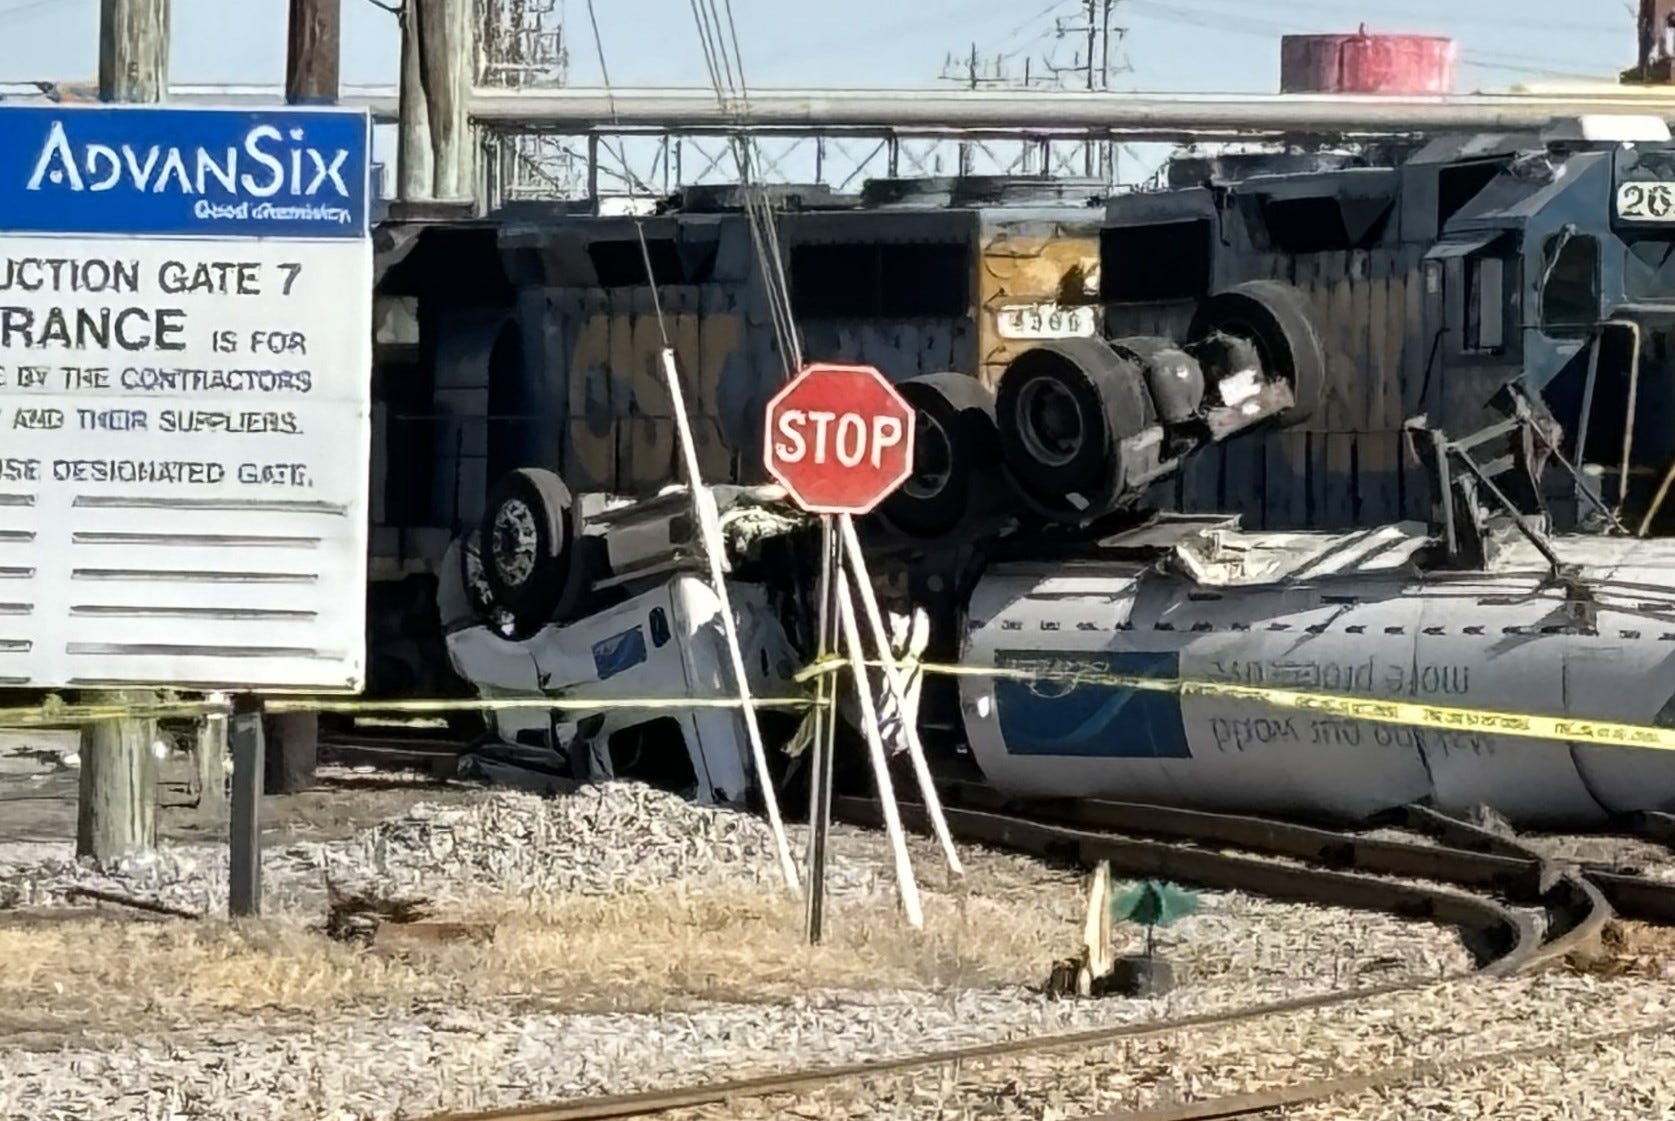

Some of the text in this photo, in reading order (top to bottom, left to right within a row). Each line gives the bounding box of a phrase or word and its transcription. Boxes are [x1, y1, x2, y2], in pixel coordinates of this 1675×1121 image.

[158, 260, 262, 295] GATE
[277, 263, 302, 296] 7
[0, 306, 307, 355] RANCE IS FOR
[60, 366, 111, 389] THE
[120, 367, 312, 392] CONTRACTORS
[775, 409, 903, 469] STOP
[53, 459, 225, 483] DESIGNATED
